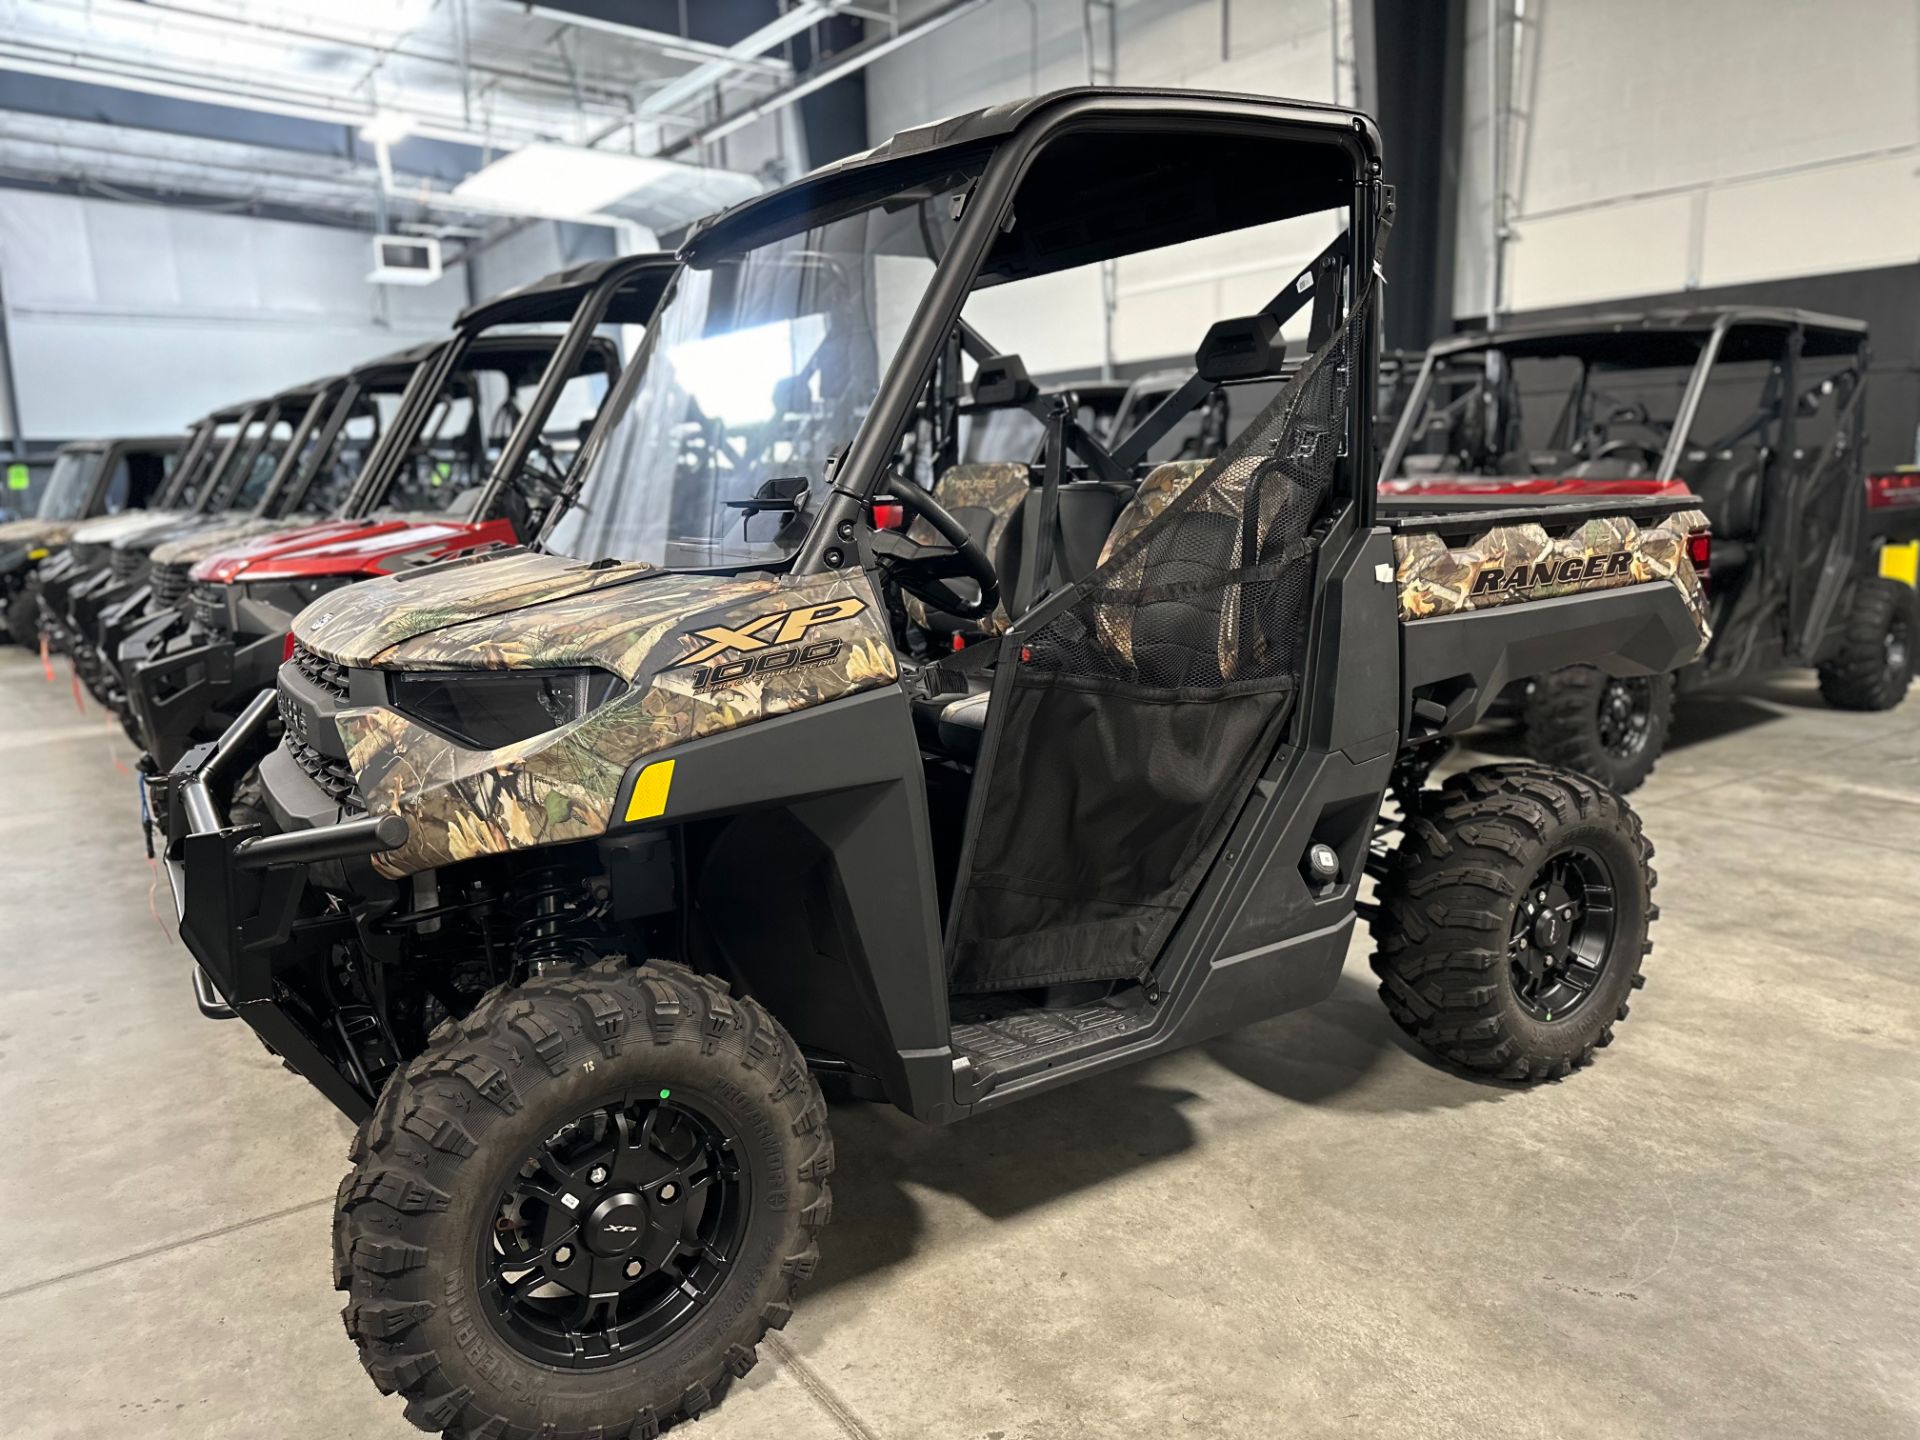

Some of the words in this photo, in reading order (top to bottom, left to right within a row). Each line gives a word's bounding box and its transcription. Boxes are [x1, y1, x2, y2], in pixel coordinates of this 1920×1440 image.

[1470, 550, 1634, 596] RANGER
[656, 596, 870, 672] XP
[692, 637, 843, 689] 1000
[603, 1224, 637, 1233] XP
